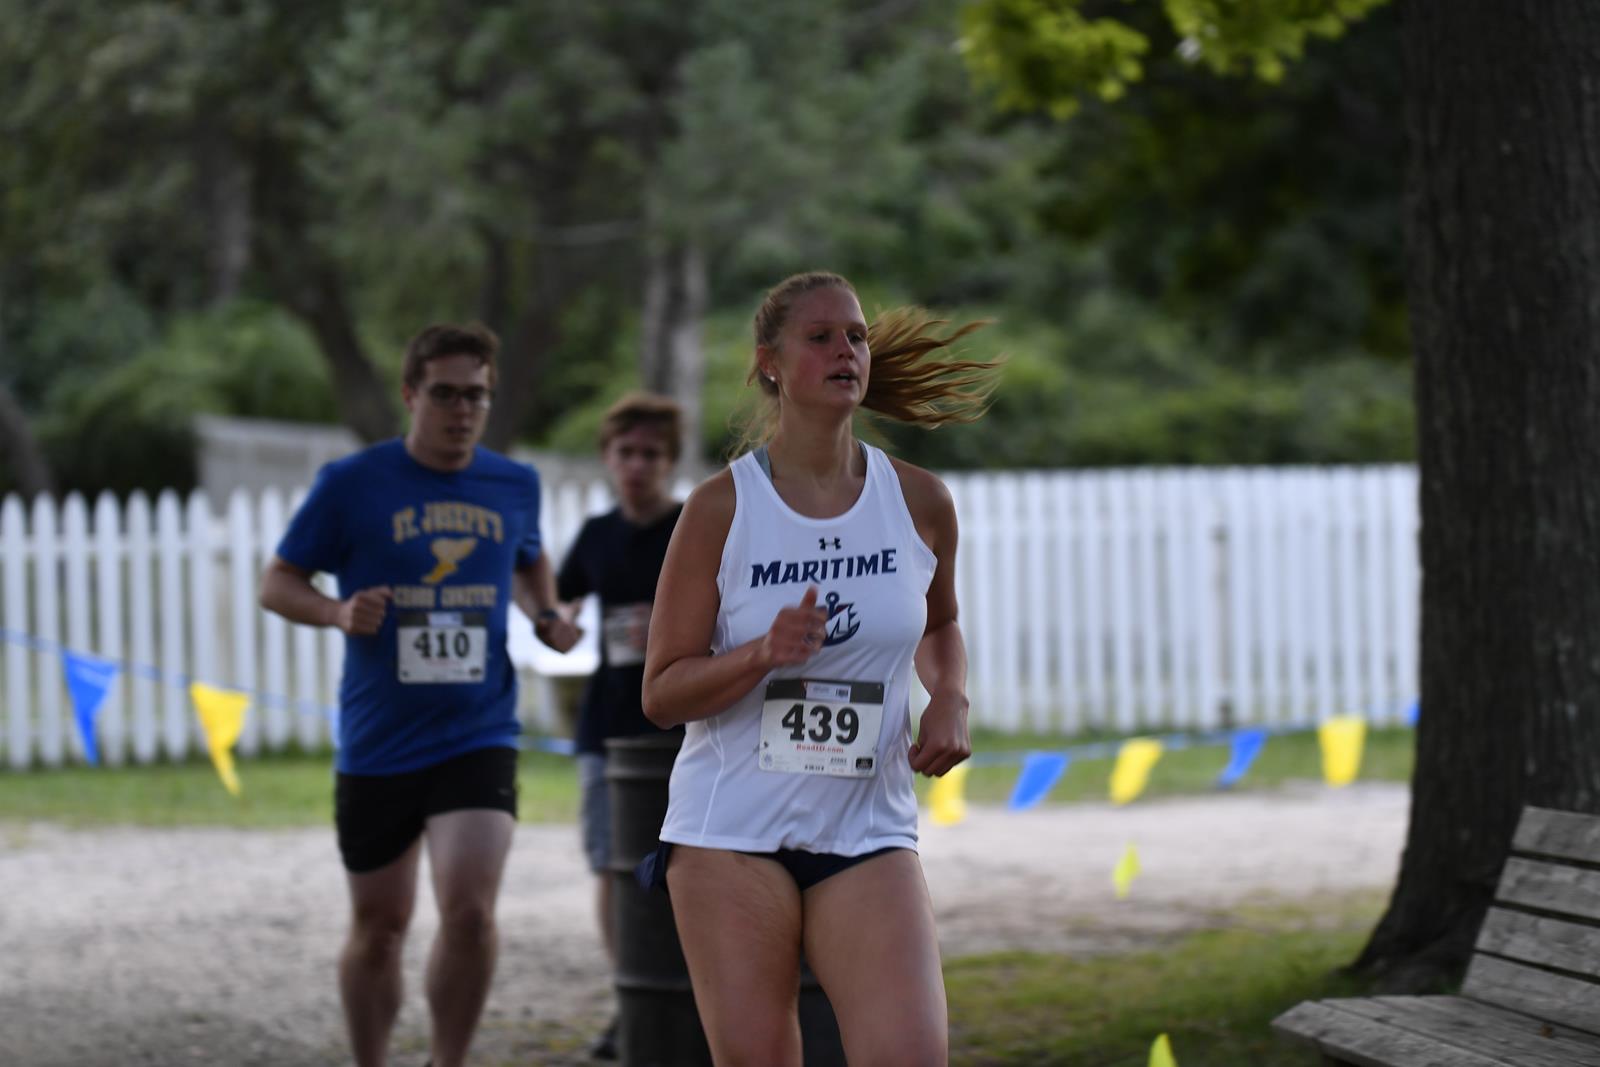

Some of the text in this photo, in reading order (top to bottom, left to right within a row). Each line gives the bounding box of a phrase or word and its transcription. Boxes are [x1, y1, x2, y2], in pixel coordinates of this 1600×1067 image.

[750, 548, 898, 589] MARITIME
[413, 629, 471, 659] 410
[781, 702, 860, 746] 439
